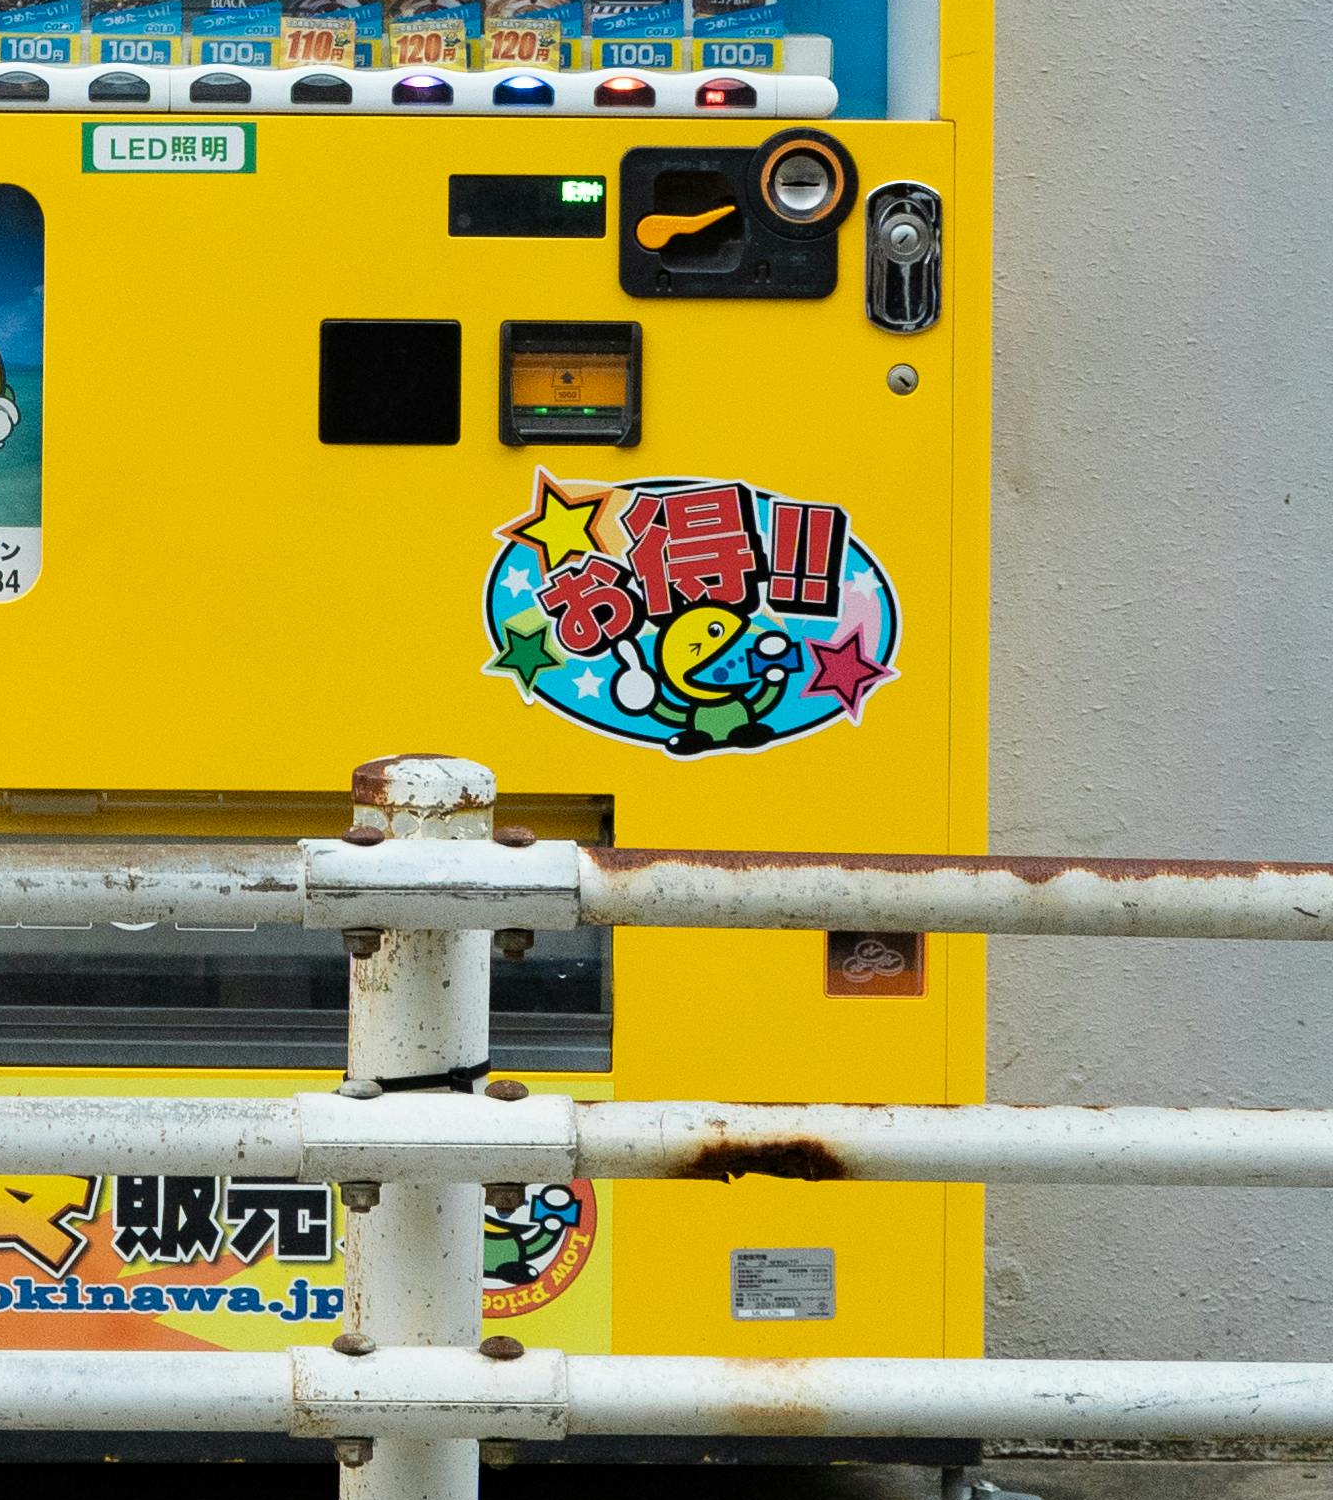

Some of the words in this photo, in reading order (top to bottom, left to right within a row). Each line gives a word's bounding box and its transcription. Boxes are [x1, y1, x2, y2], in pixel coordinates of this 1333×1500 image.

[396, 32, 456, 64] 120円
[491, 30, 550, 62] 120円
[645, 27, 675, 37] COLD
[110, 135, 229, 164] LED照明
[550, 1232, 591, 1287] Low
